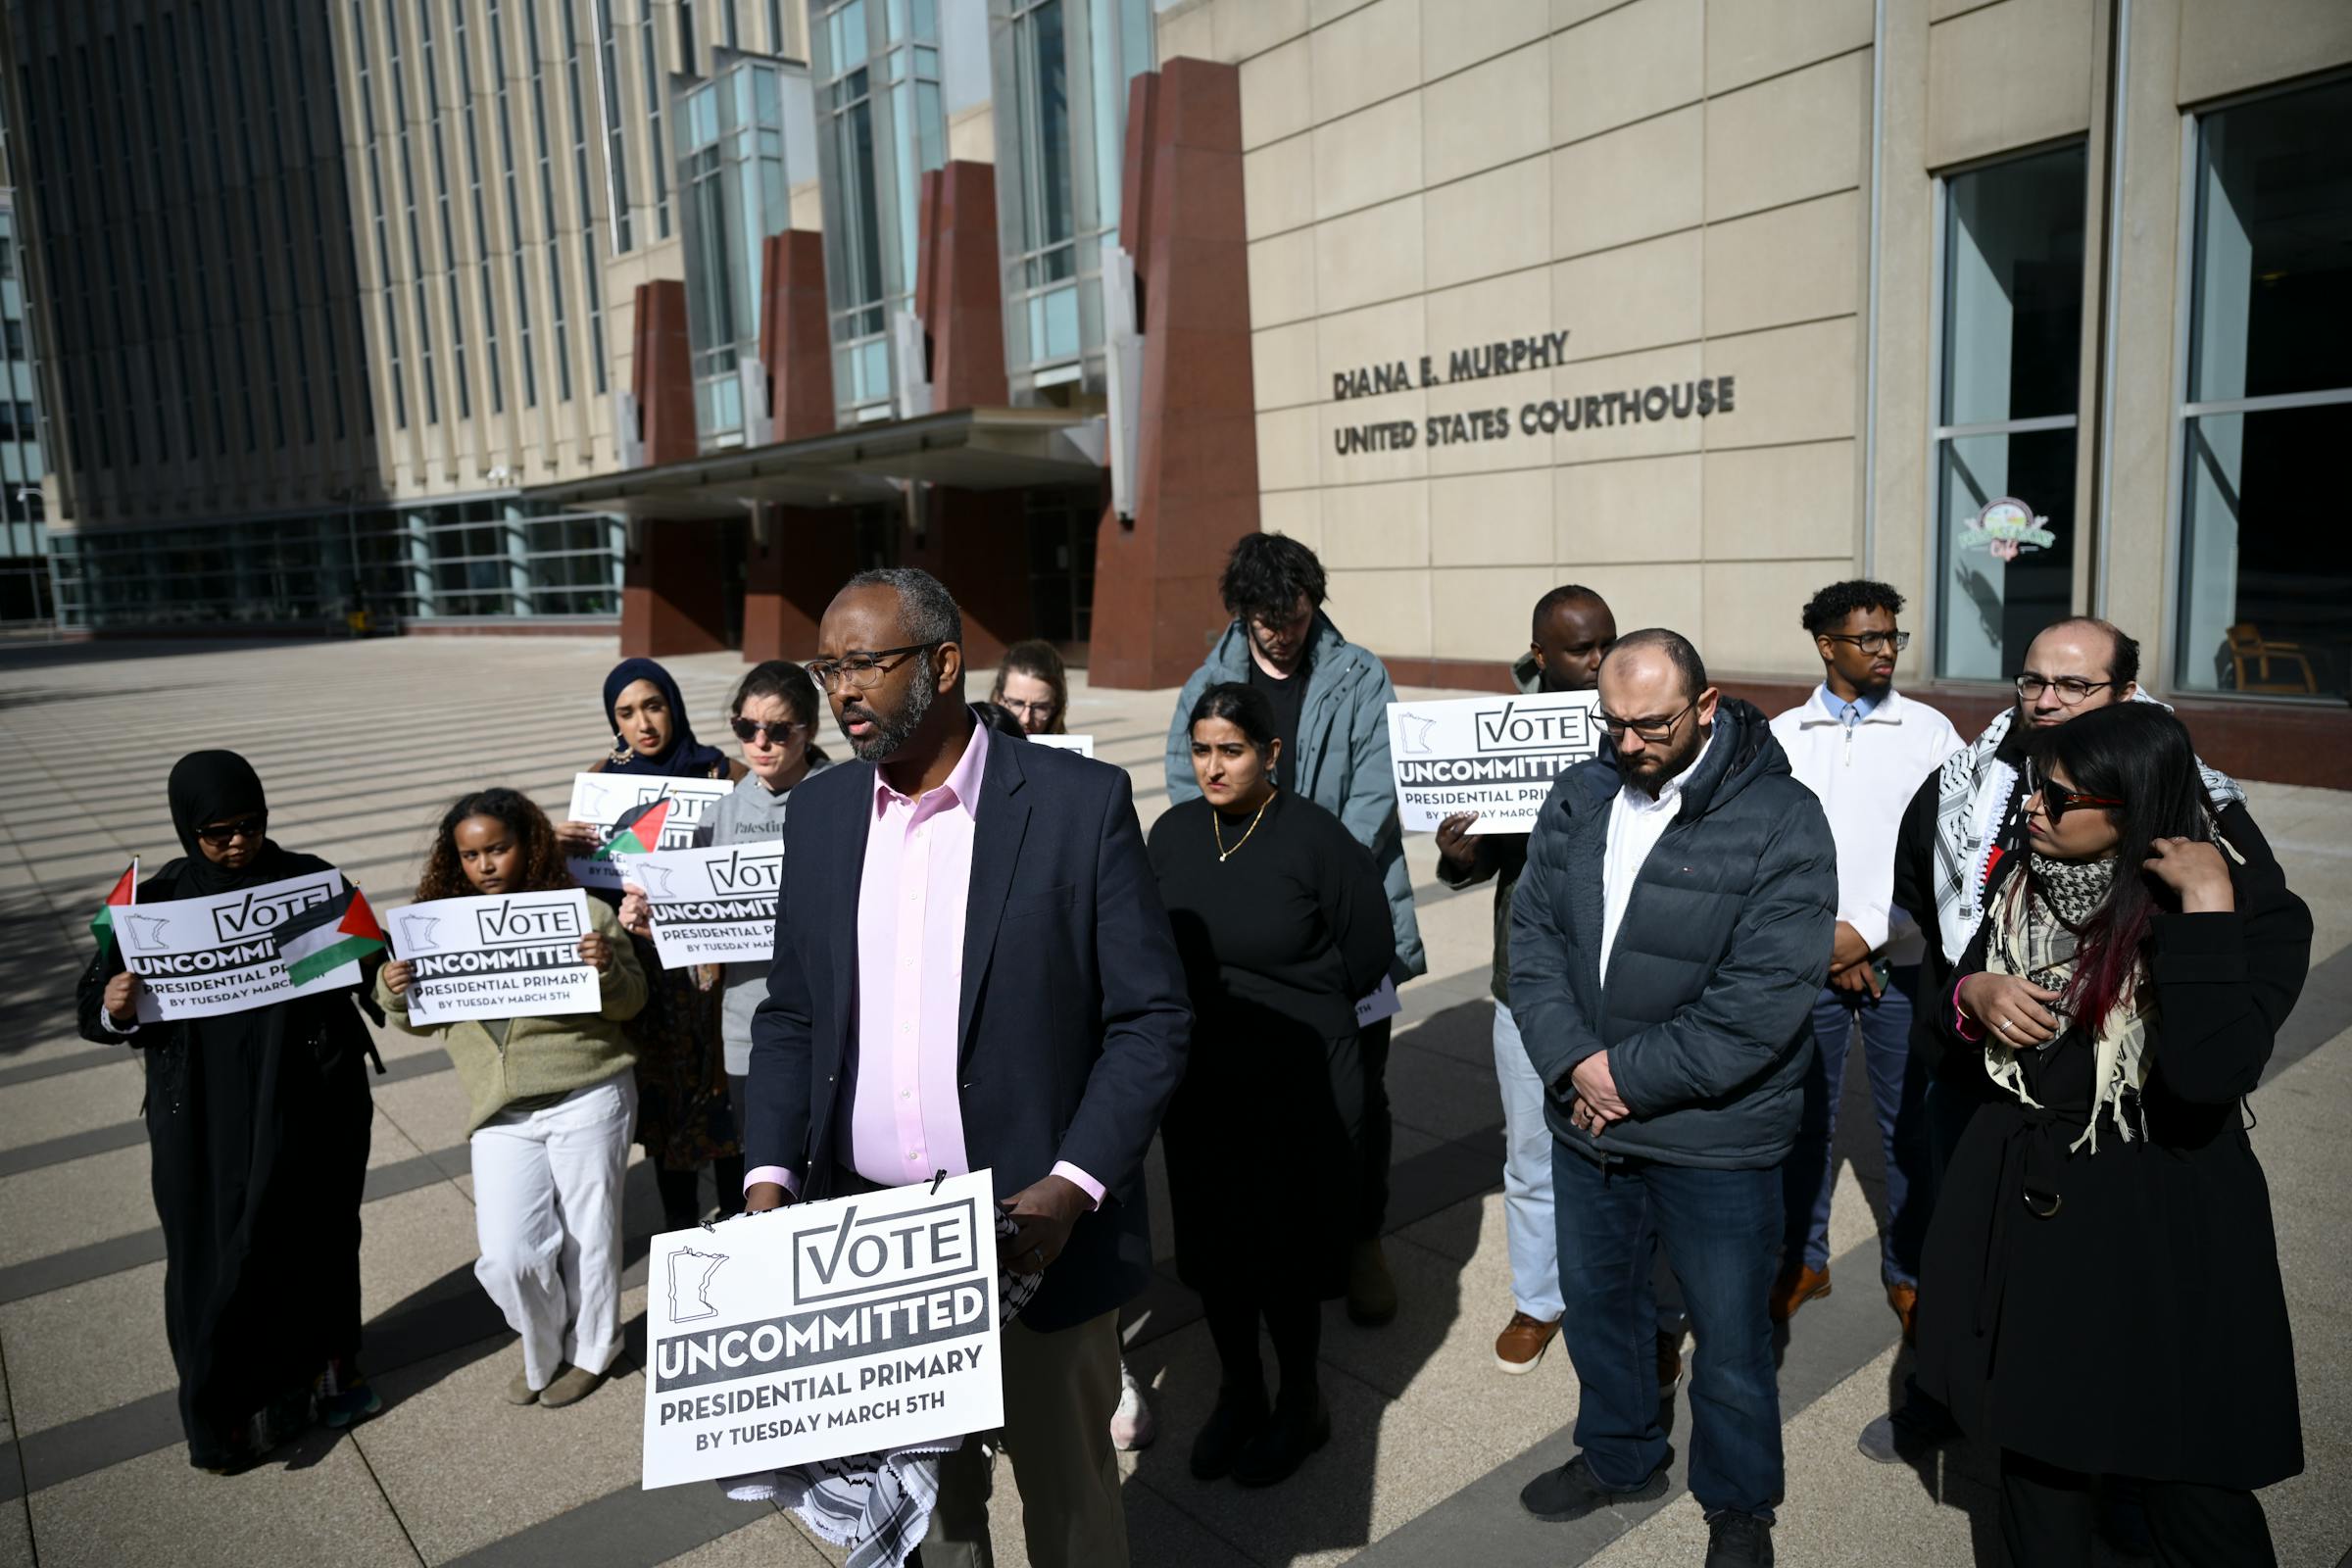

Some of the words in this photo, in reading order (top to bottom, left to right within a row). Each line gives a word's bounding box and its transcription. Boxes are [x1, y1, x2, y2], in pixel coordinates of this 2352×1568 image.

[1333, 361, 1412, 400] DIANA
[1419, 356, 1440, 388] E.
[1448, 329, 1572, 383] MURPHY
[1335, 419, 1417, 456] UNITED
[1426, 407, 1509, 448] STATES
[1520, 375, 1736, 436] COURTHOUSE
[1485, 702, 1579, 743] VOTE
[1405, 790, 1513, 805] PRESIDENTIAL
[1426, 810, 1439, 819] BY
[715, 850, 778, 888] VOT
[485, 900, 572, 936] VOTE
[662, 926, 761, 942] PRESIDENTIAL
[686, 944, 700, 953] BY
[704, 942, 750, 952] TUESDAY
[144, 970, 265, 995] PRESIDENTIAL
[170, 998, 185, 1006] BY
[190, 990, 248, 1005] TUESDAY
[415, 978, 519, 998] PRESIDENTIAL
[523, 972, 588, 988] PRIMARY
[438, 1001, 452, 1009] BY
[457, 997, 504, 1007] TUESDAY
[508, 993, 547, 1004] MARCH
[550, 992, 570, 1001] 5TH
[807, 1205, 961, 1285] VOTE
[657, 1286, 983, 1380] UNCOMMITTED
[661, 1374, 852, 1426] PRESIDENTIAL
[859, 1345, 983, 1391] PRIMARY
[696, 1430, 724, 1451] BY
[729, 1413, 821, 1446] TUESDAY
[827, 1398, 900, 1429] MARCH
[906, 1391, 945, 1414] 5TH
